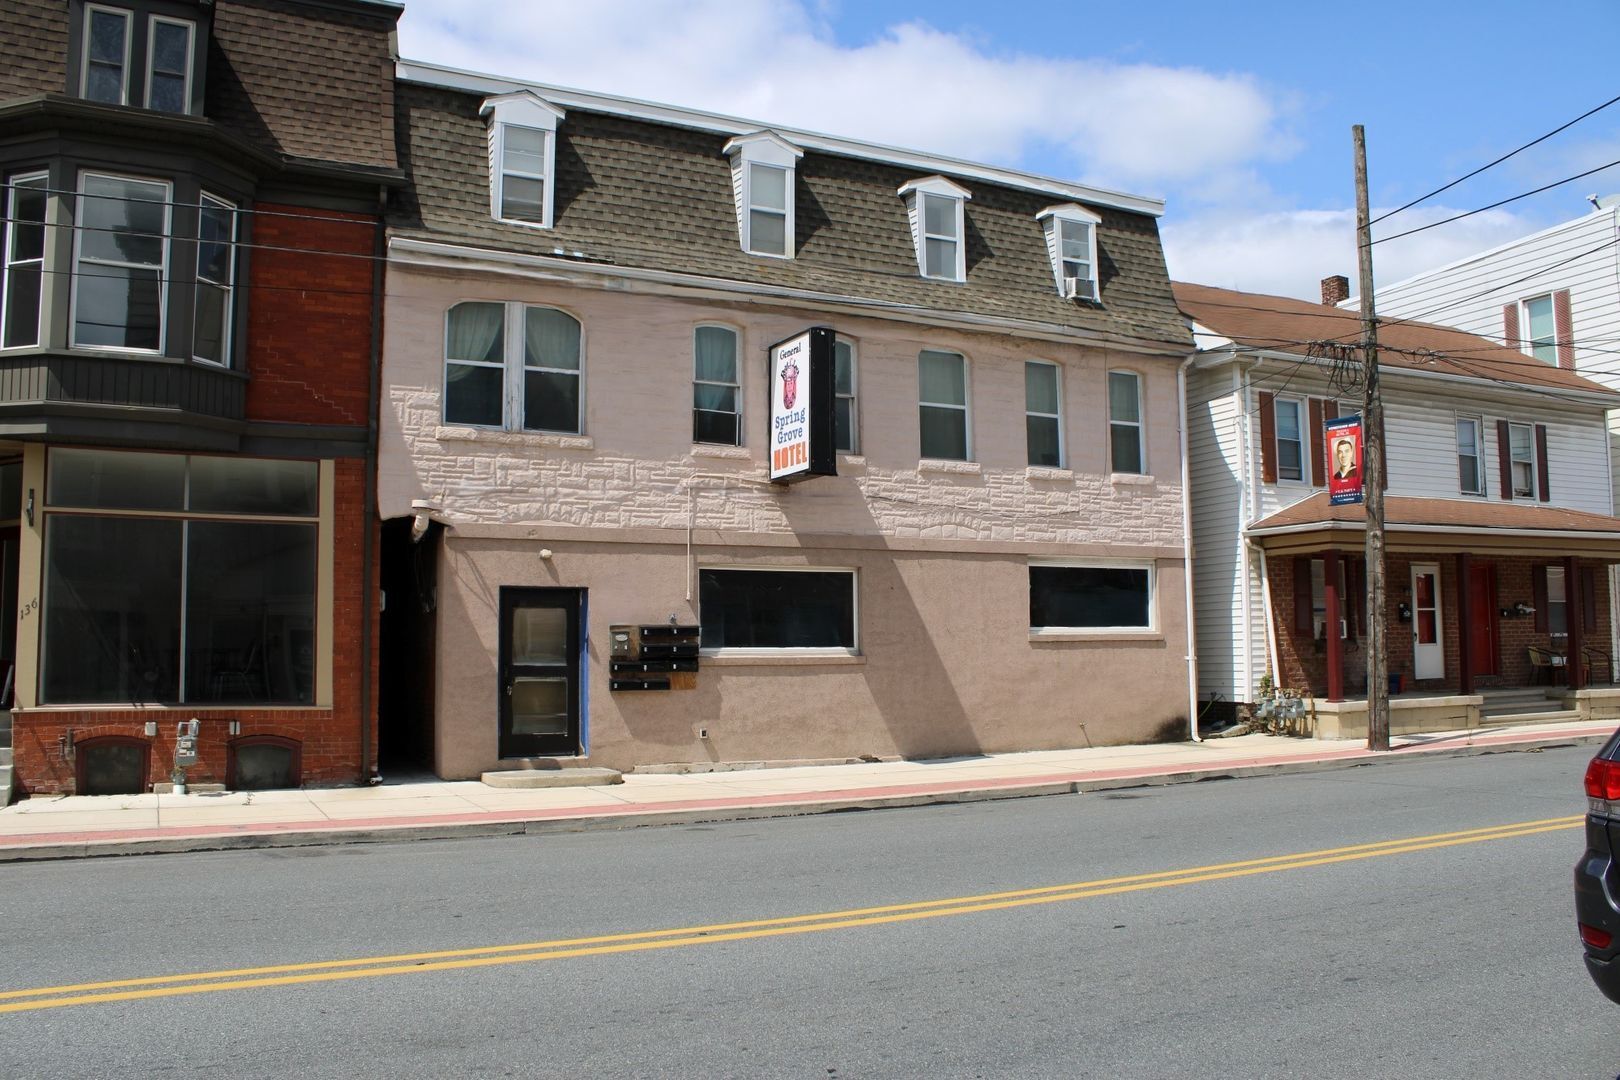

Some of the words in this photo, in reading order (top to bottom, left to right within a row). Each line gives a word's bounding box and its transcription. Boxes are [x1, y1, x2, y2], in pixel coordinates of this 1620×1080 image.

[780, 342, 801, 360] General
[775, 407, 805, 430] Spring
[777, 427, 803, 444] Grove
[774, 441, 807, 471] HOTEL
[20, 597, 38, 620] 136
